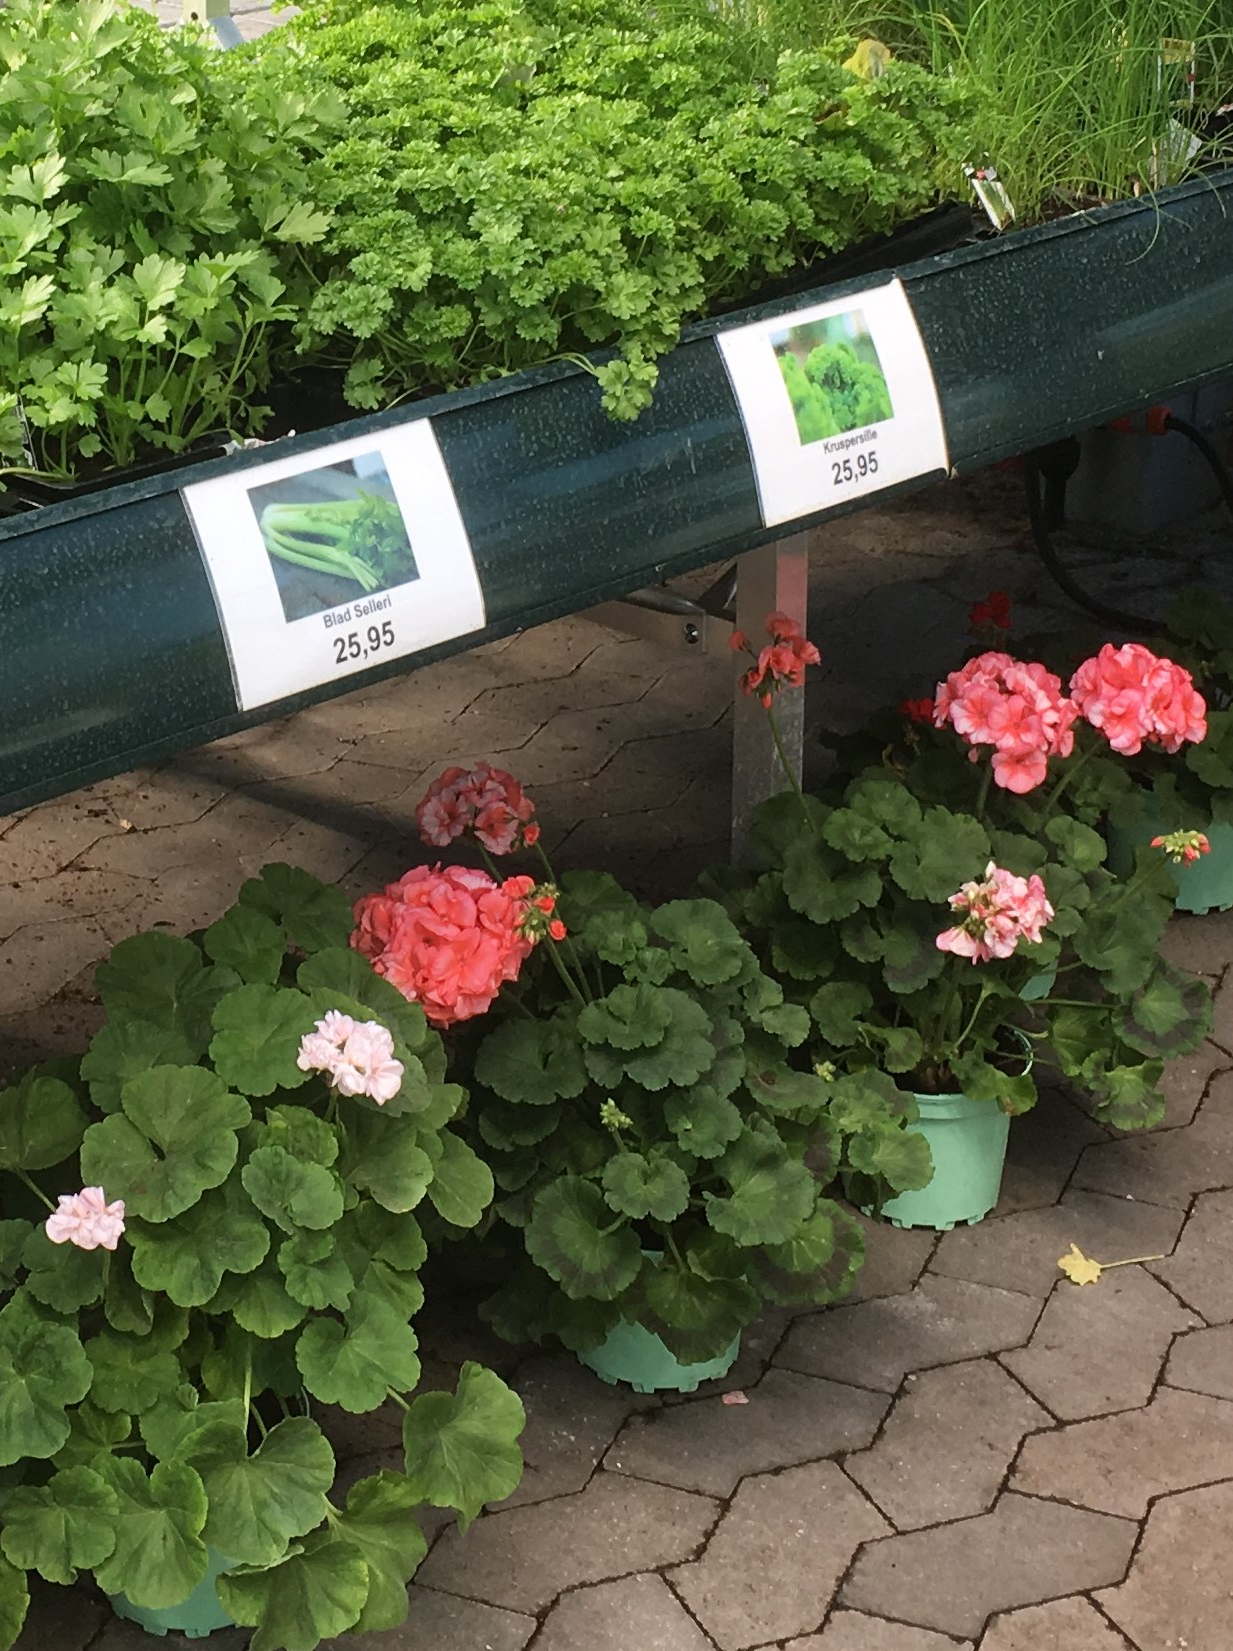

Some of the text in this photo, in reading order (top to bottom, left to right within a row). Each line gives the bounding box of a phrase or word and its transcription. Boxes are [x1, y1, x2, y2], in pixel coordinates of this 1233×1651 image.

[822, 429, 878, 455] Kruspersille
[831, 450, 879, 485] 25,95
[322, 594, 392, 629] Blad Selleri
[333, 620, 396, 665] 25,95
